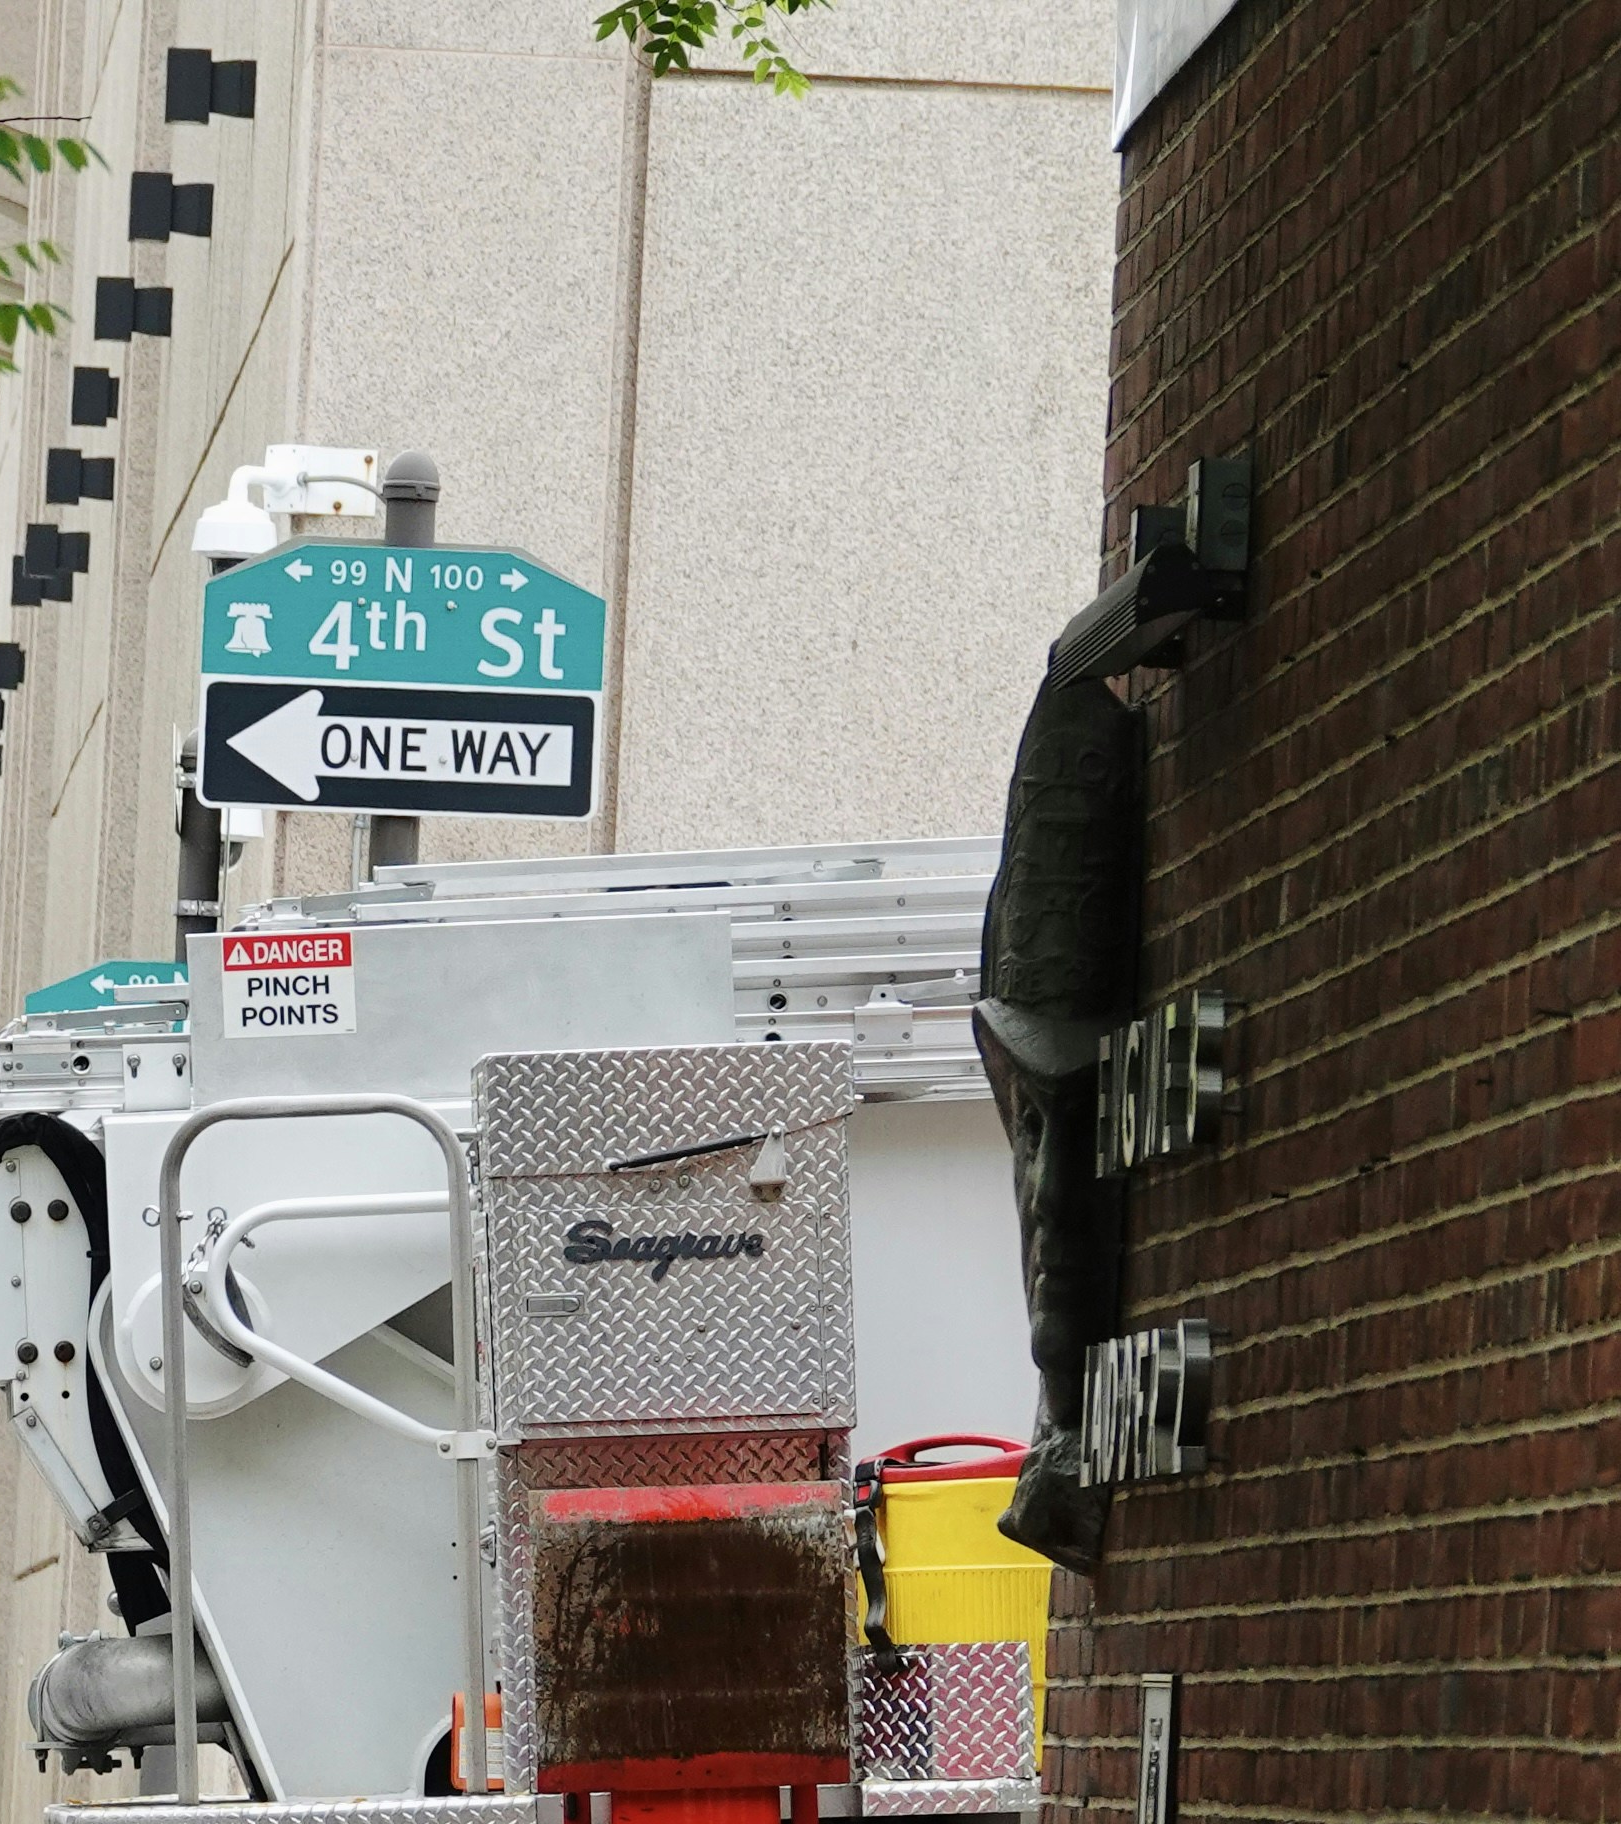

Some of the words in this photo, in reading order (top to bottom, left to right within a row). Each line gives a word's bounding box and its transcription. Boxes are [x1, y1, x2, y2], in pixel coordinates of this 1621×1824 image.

[330, 559, 368, 586] 99
[383, 557, 414, 593] N
[430, 565, 485, 593] 100
[308, 600, 427, 671] 4th
[477, 607, 568, 680] St
[320, 724, 427, 773] ONE
[451, 730, 552, 778] WAY
[252, 938, 345, 965] DANGER
[247, 976, 331, 999] PINCH
[241, 1002, 339, 1028] POINTS
